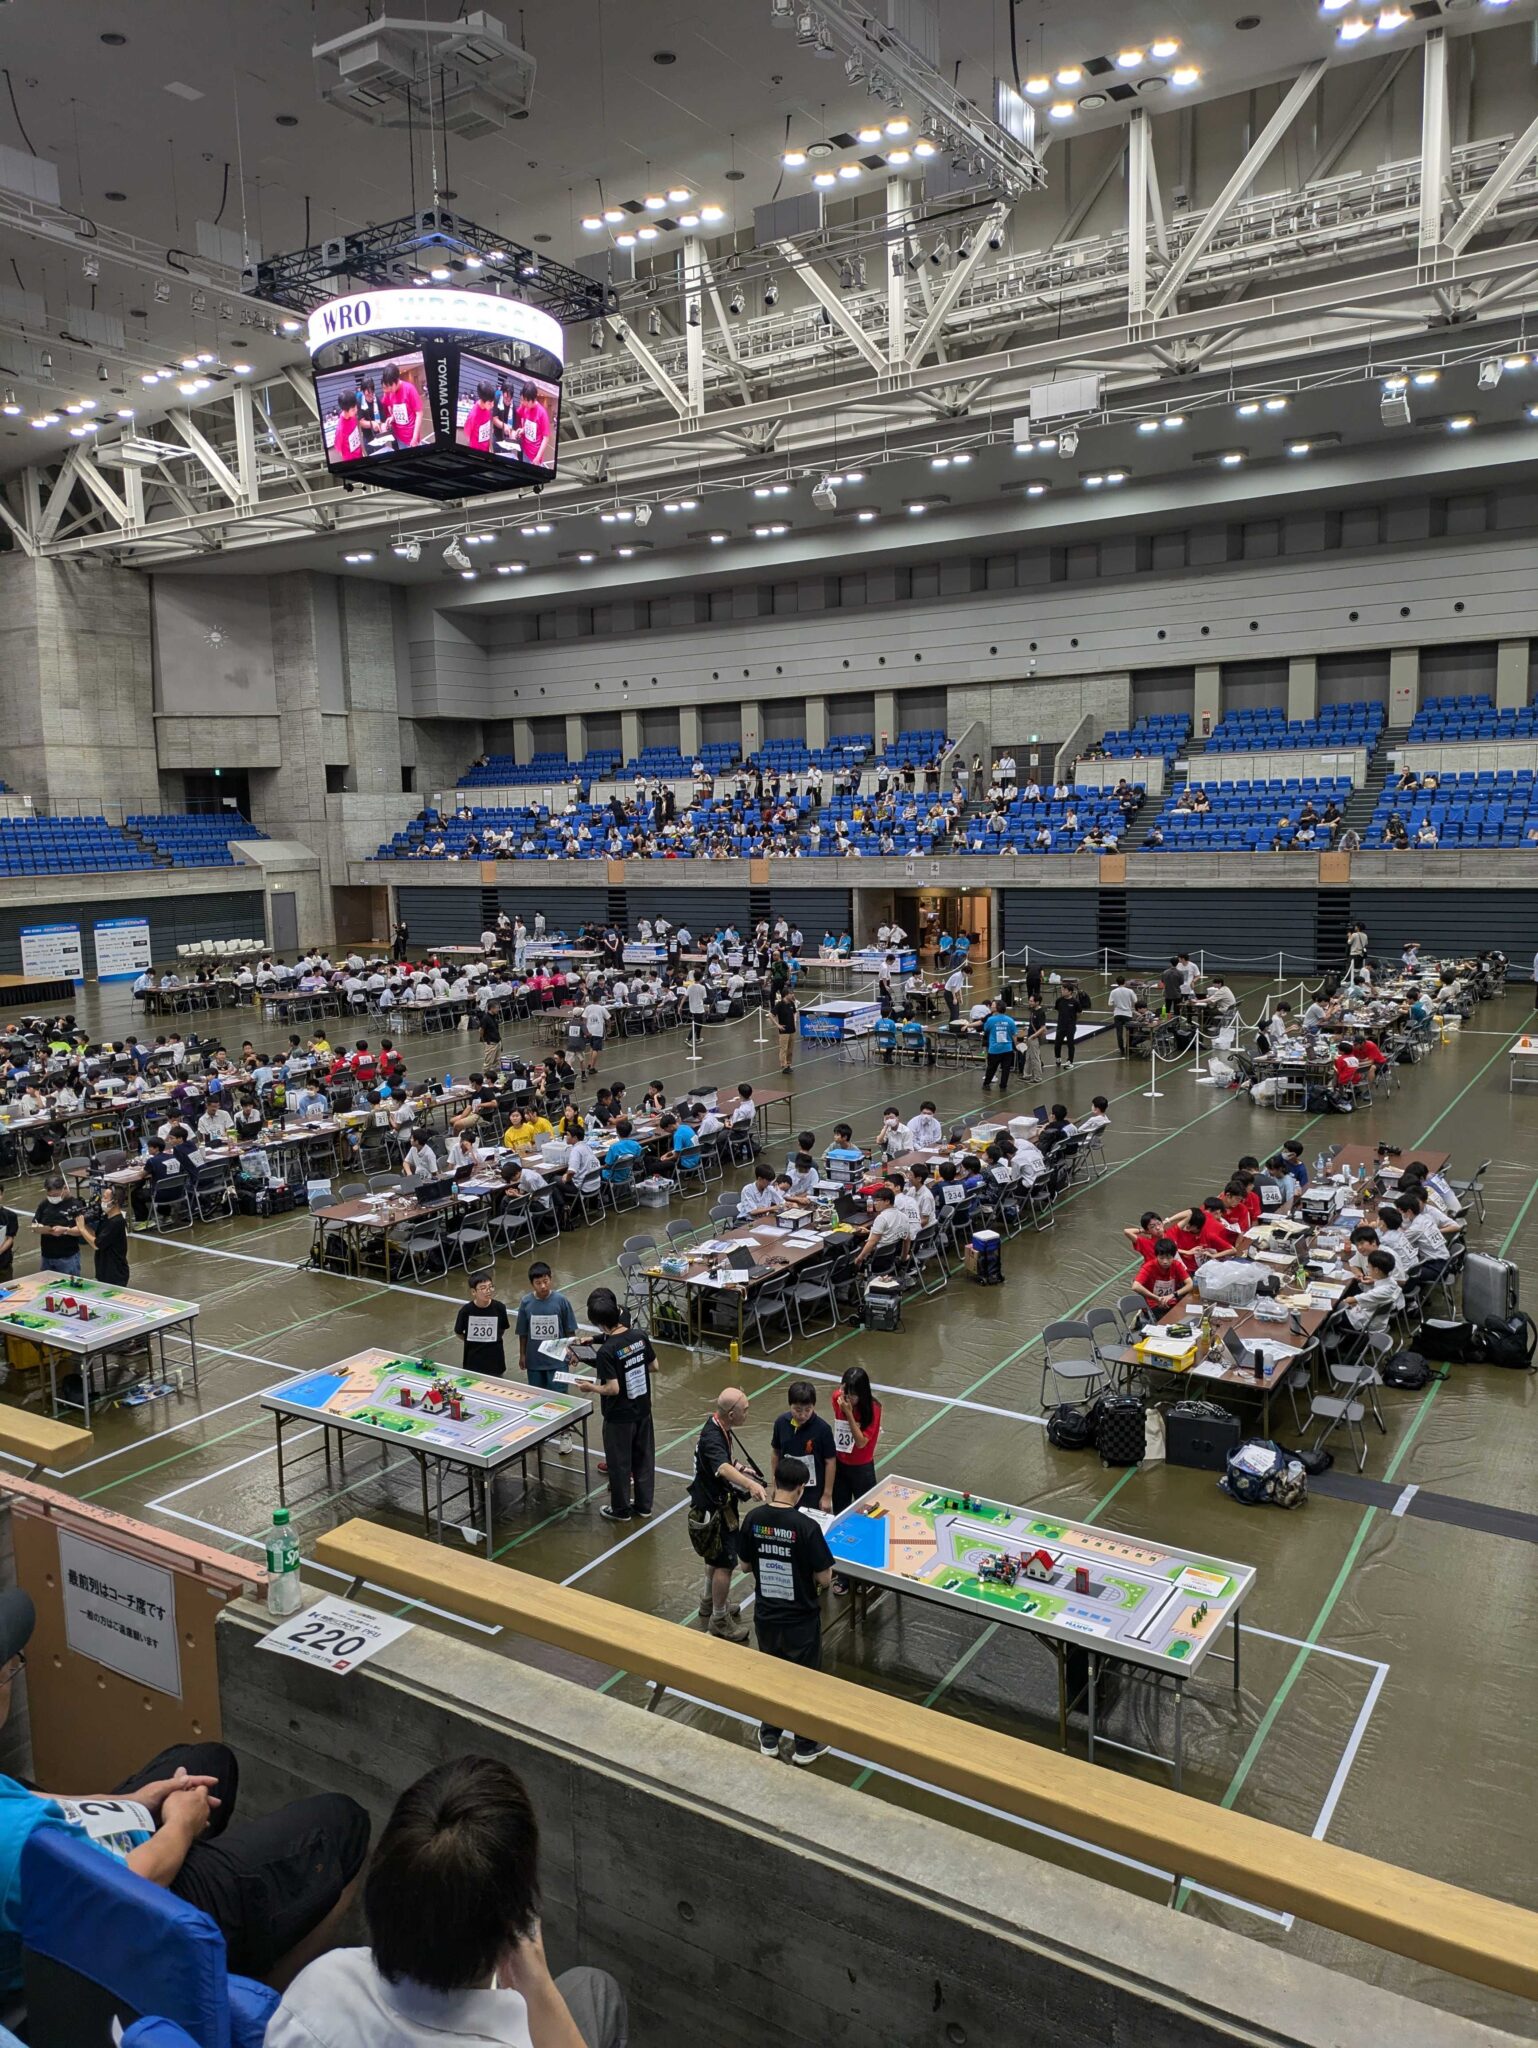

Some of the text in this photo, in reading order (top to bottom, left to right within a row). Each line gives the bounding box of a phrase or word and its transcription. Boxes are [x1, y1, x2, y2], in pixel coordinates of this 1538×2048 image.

[322, 300, 372, 335] WRO
[437, 357, 450, 435] TOYAMA CITY
[947, 1191, 962, 1200] 234
[473, 1327, 493, 1336] 230
[535, 1325, 555, 1335] 230
[624, 1353, 645, 1368] JUDGE
[774, 1527, 792, 1539] WRO
[758, 1543, 791, 1557] JUDGE
[68, 1569, 166, 1621] 最前列はコーチ席です
[287, 1622, 366, 1656] 220
